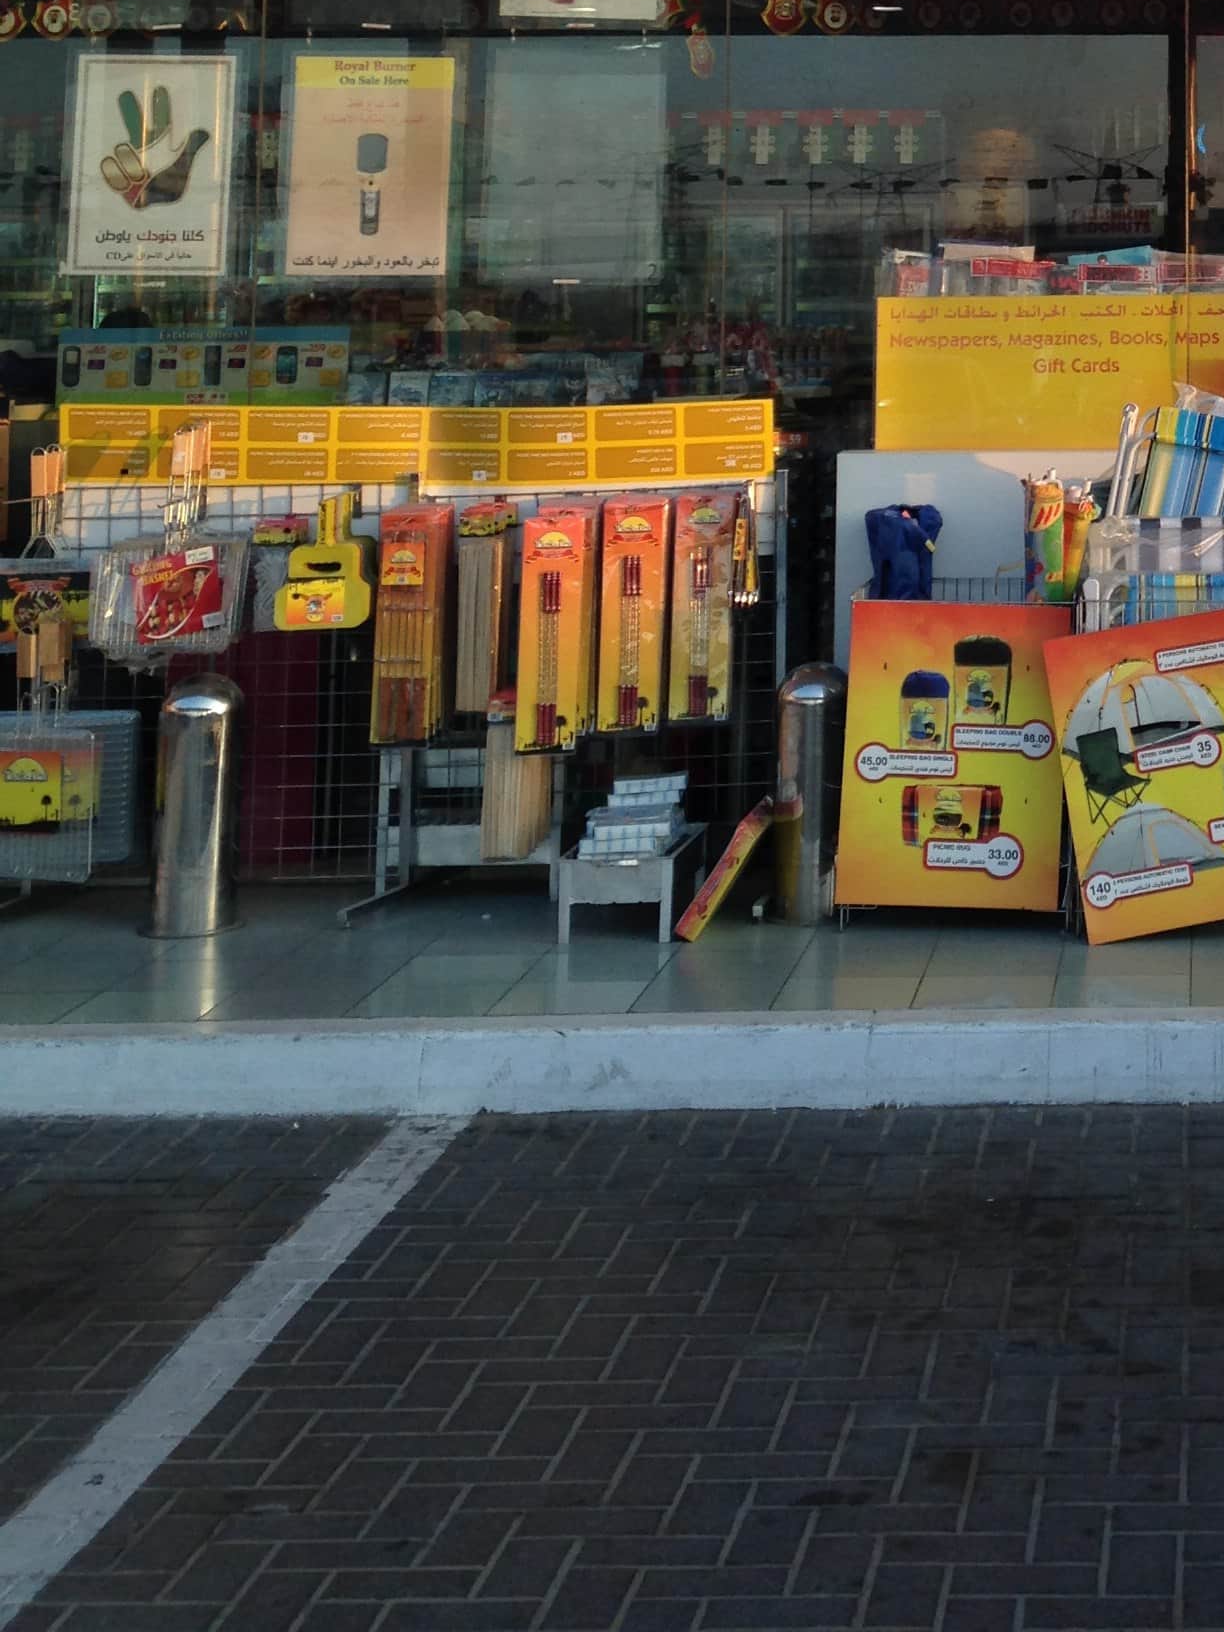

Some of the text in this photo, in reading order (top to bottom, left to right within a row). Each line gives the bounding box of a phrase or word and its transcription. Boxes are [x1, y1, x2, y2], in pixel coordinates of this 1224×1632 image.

[334, 60, 416, 73] Royal Burner
[339, 76, 409, 86] On Sale Here
[1015, 305, 1066, 320] الخرائط
[1080, 304, 1126, 319] الكتب
[890, 333, 1002, 350] Newspapers,
[1008, 332, 1102, 350] Magazines,
[1109, 331, 1168, 347] Books,
[1175, 332, 1220, 347] Maps
[1033, 358, 1120, 374] Gift Cards
[1197, 741, 1212, 753] 35
[860, 756, 888, 767] 45.00
[988, 849, 1018, 860] 33.00
[1089, 882, 1111, 896] 140
